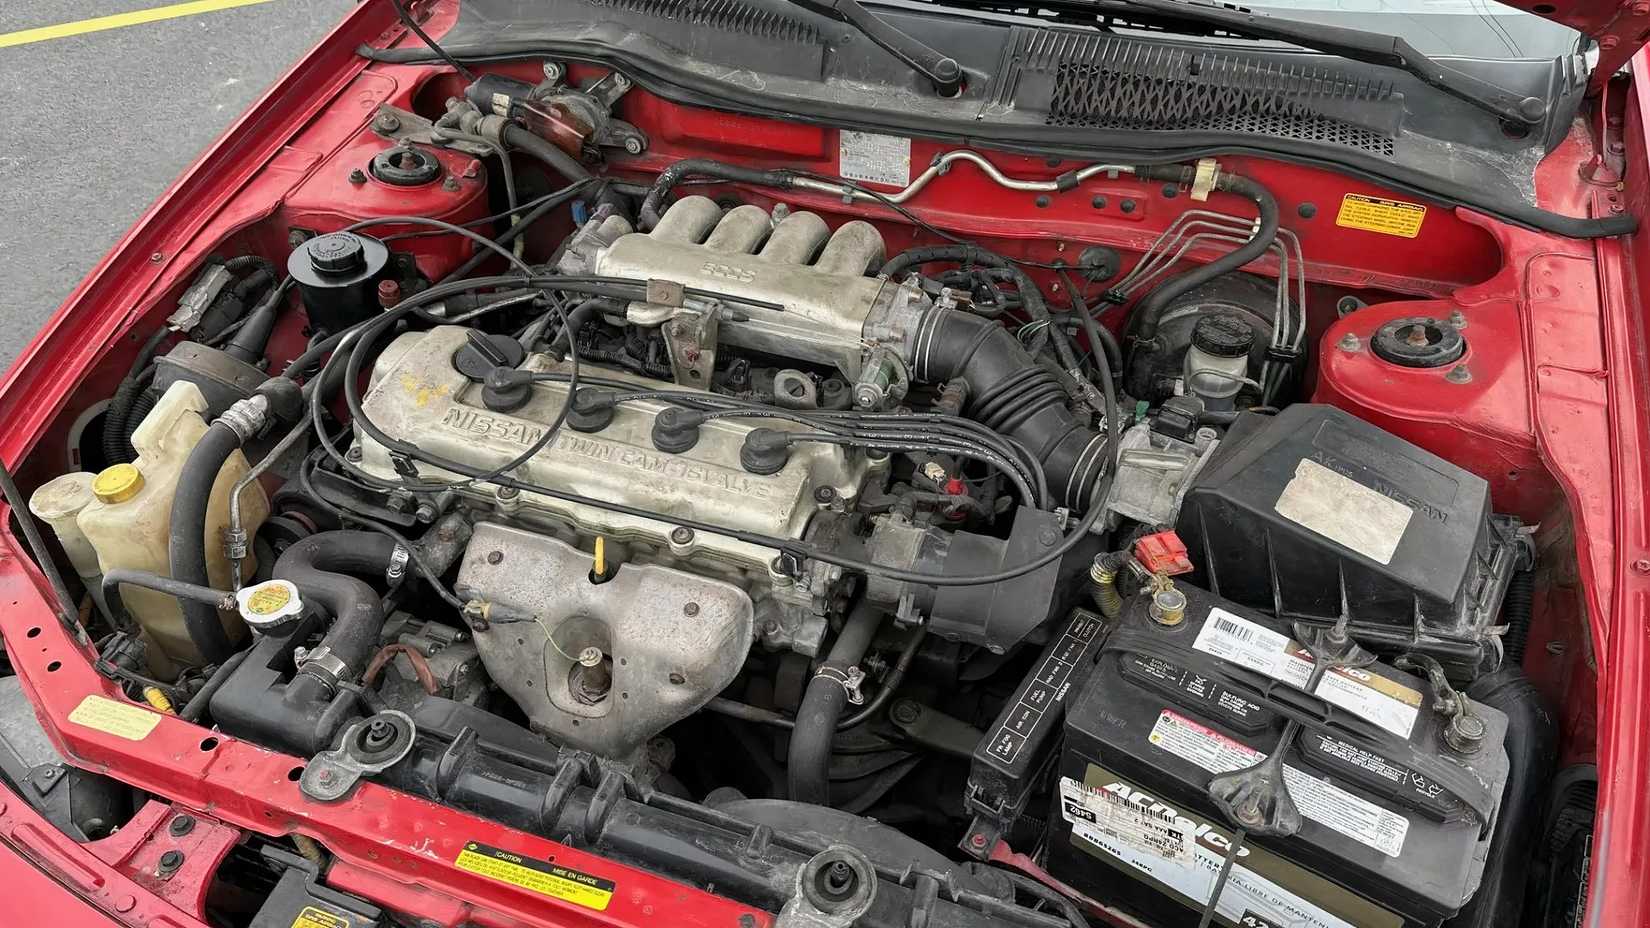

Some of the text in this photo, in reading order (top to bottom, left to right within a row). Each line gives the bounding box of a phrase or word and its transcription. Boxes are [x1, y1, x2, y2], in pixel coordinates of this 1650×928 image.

[441, 406, 545, 447] NISSAN
[1373, 475, 1452, 529] NISSAN
[1030, 688, 1040, 701] FUEL
[1036, 690, 1047, 703] PUMP
[1055, 681, 1070, 701] NISSAN
[1001, 741, 1013, 756] LAMP
[552, 867, 567, 876] MISE
[576, 874, 597, 884] GARDE
